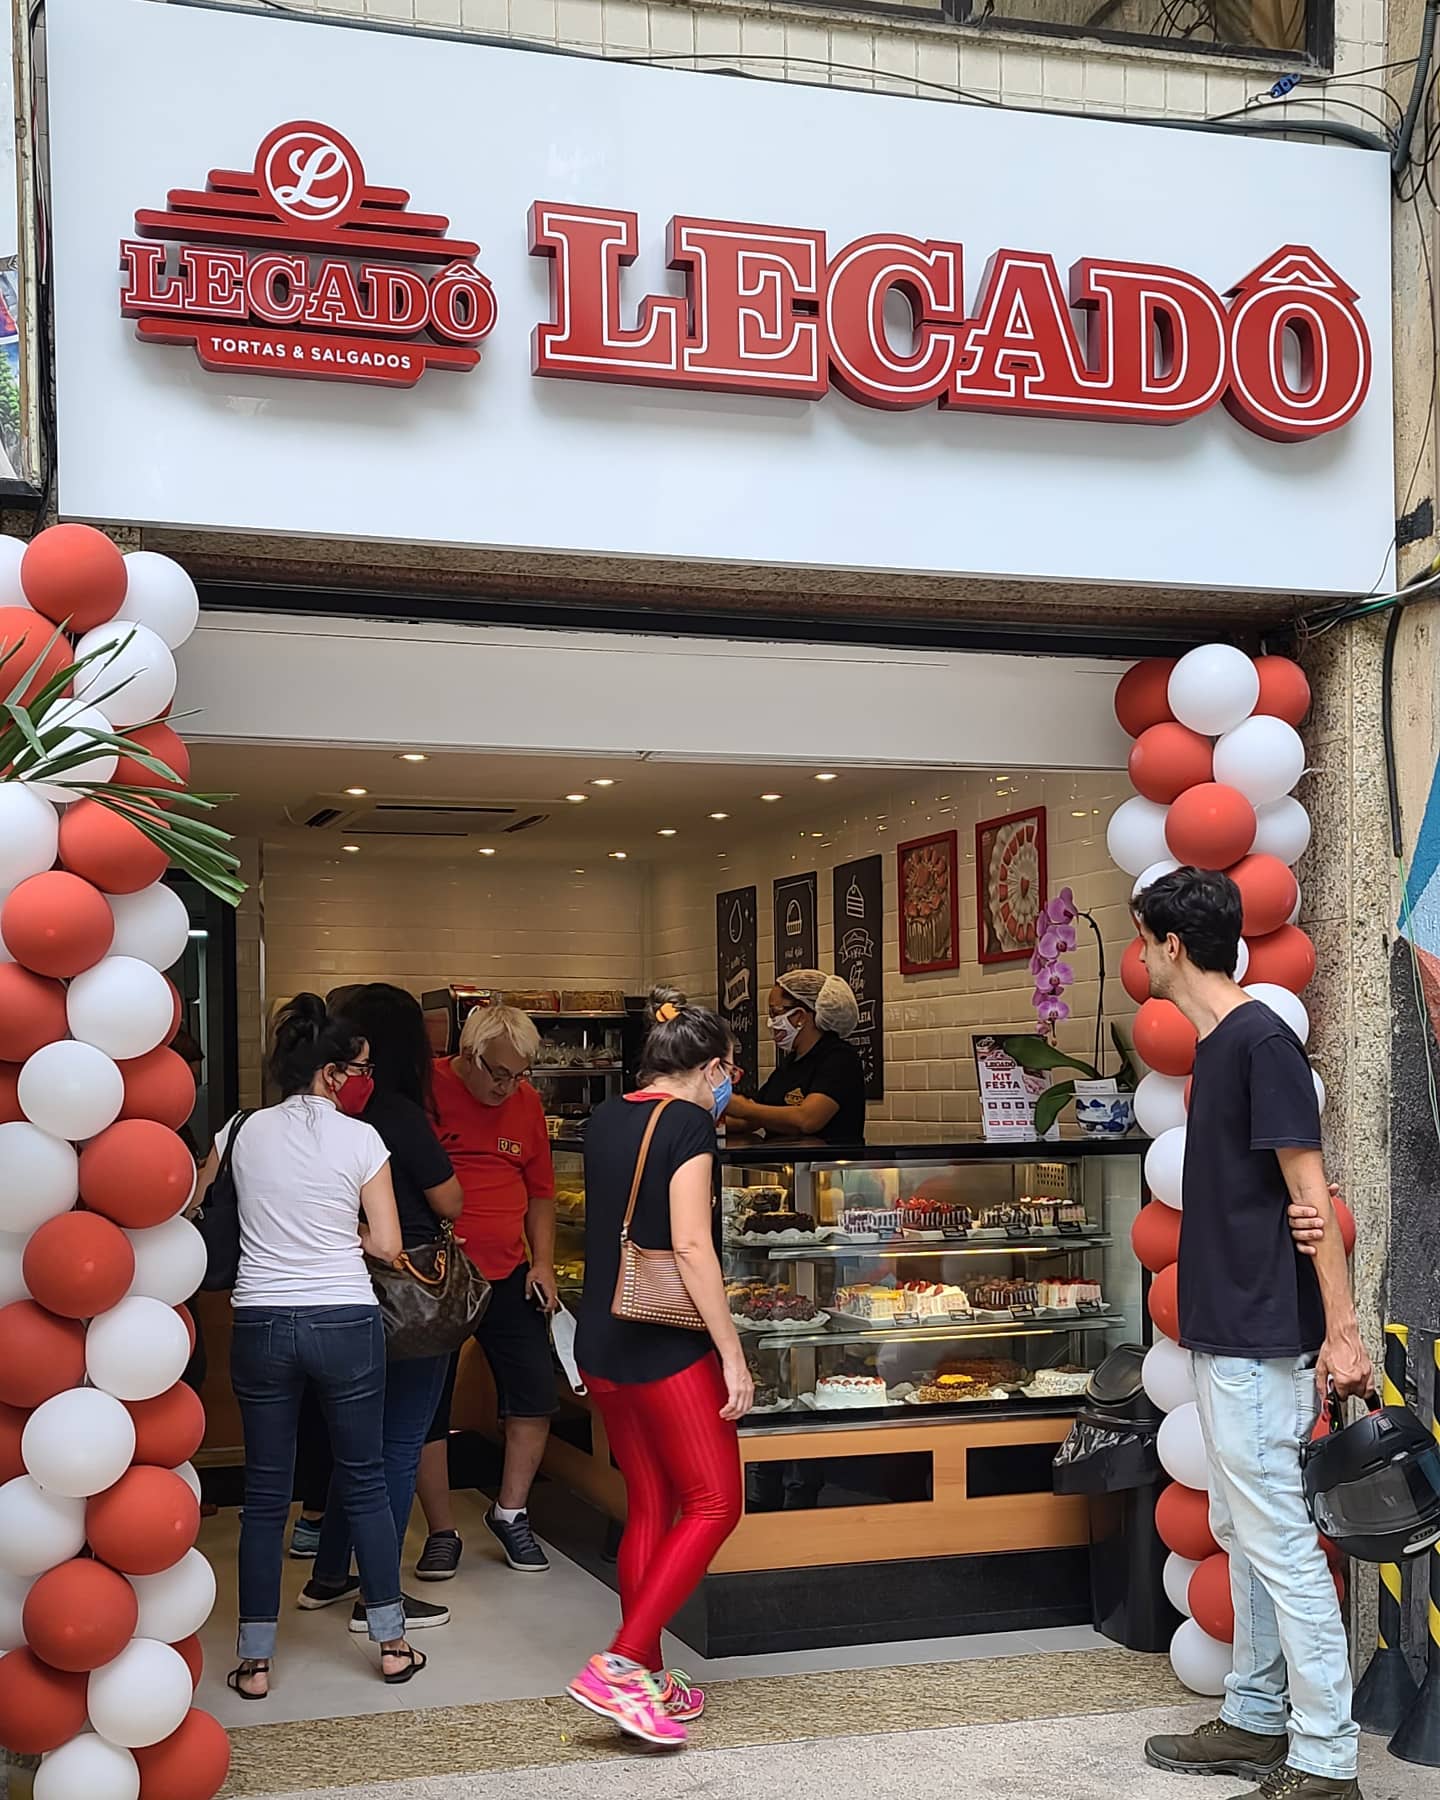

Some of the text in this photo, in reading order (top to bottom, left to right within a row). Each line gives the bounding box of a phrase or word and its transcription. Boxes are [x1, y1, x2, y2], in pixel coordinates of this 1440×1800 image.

[120, 239, 499, 347] LECADÔ
[528, 200, 1372, 441] LECADÔ
[211, 337, 411, 369] TORTAS & SALGADOS
[985, 1081, 1021, 1089] FESTA
[992, 1072, 1012, 1081] KIT
